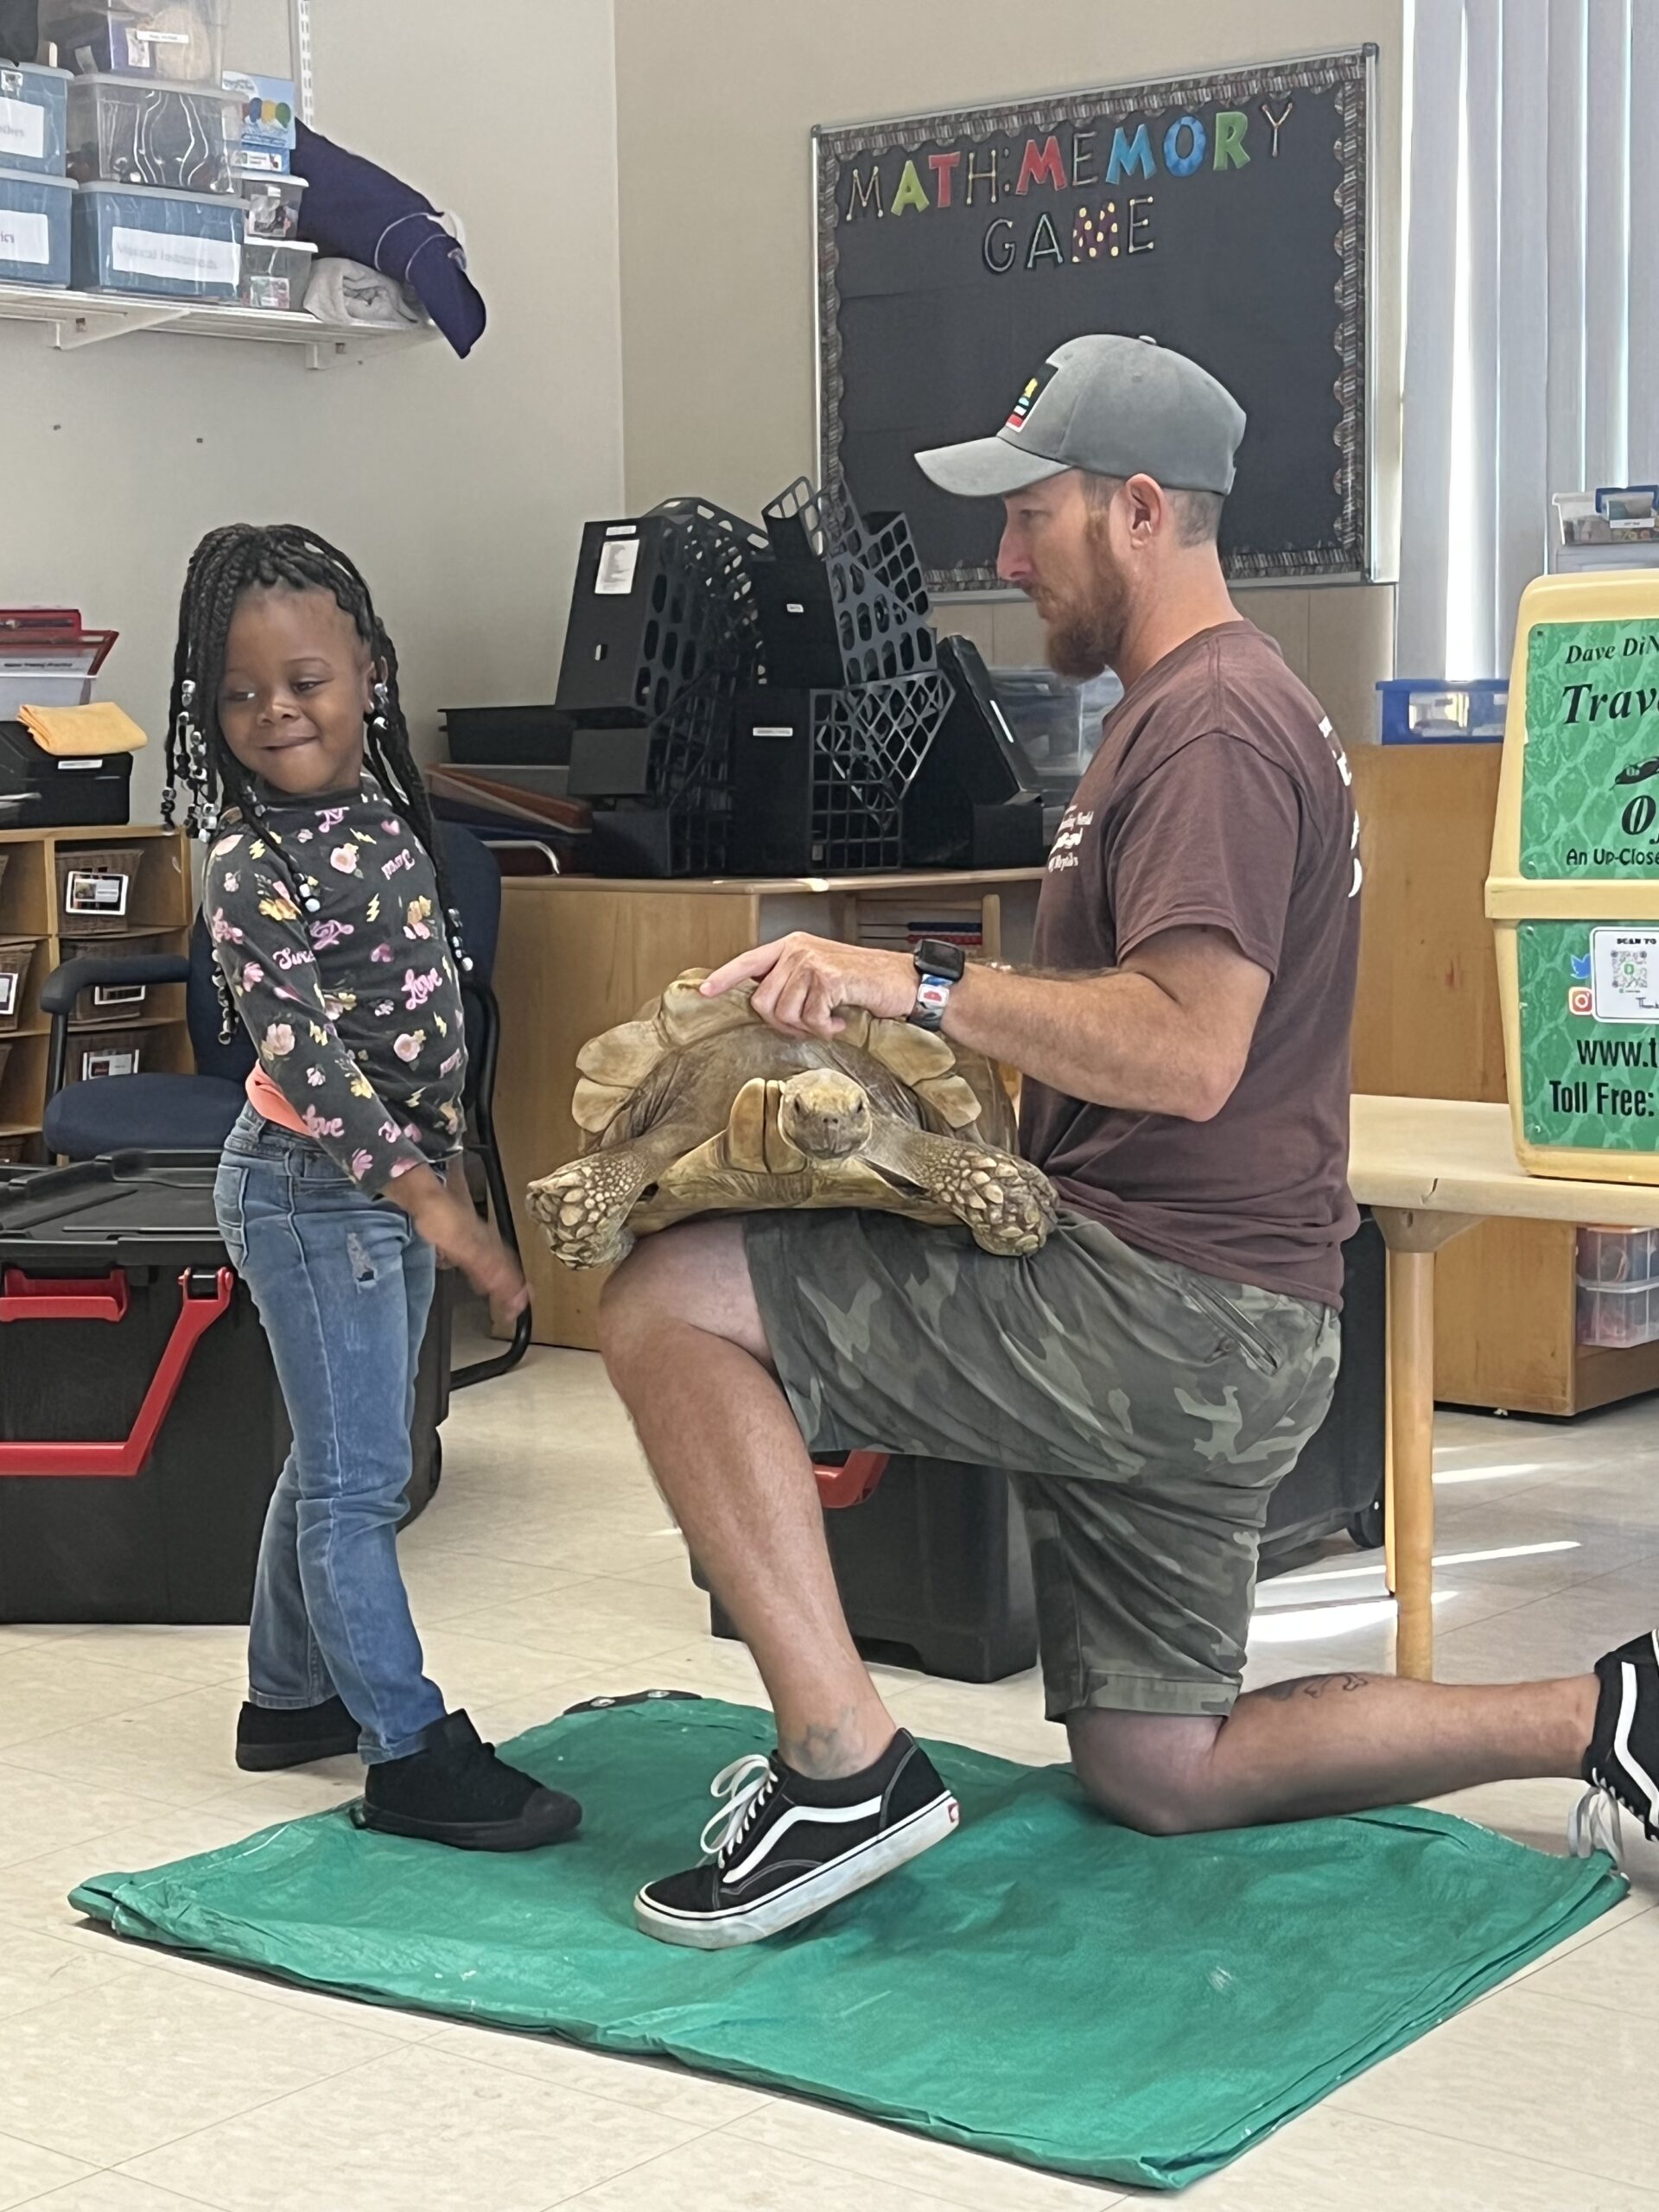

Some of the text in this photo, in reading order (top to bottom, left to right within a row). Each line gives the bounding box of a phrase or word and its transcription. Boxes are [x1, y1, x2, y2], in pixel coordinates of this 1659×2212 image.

[1014, 102, 1293, 196] MEMORY
[982, 195, 1154, 274] GAME
[1565, 645, 1615, 664] Dave
[1561, 683, 1659, 725] Trav
[1567, 849, 1588, 865] An
[1549, 1080, 1655, 1117] Toll Free:
